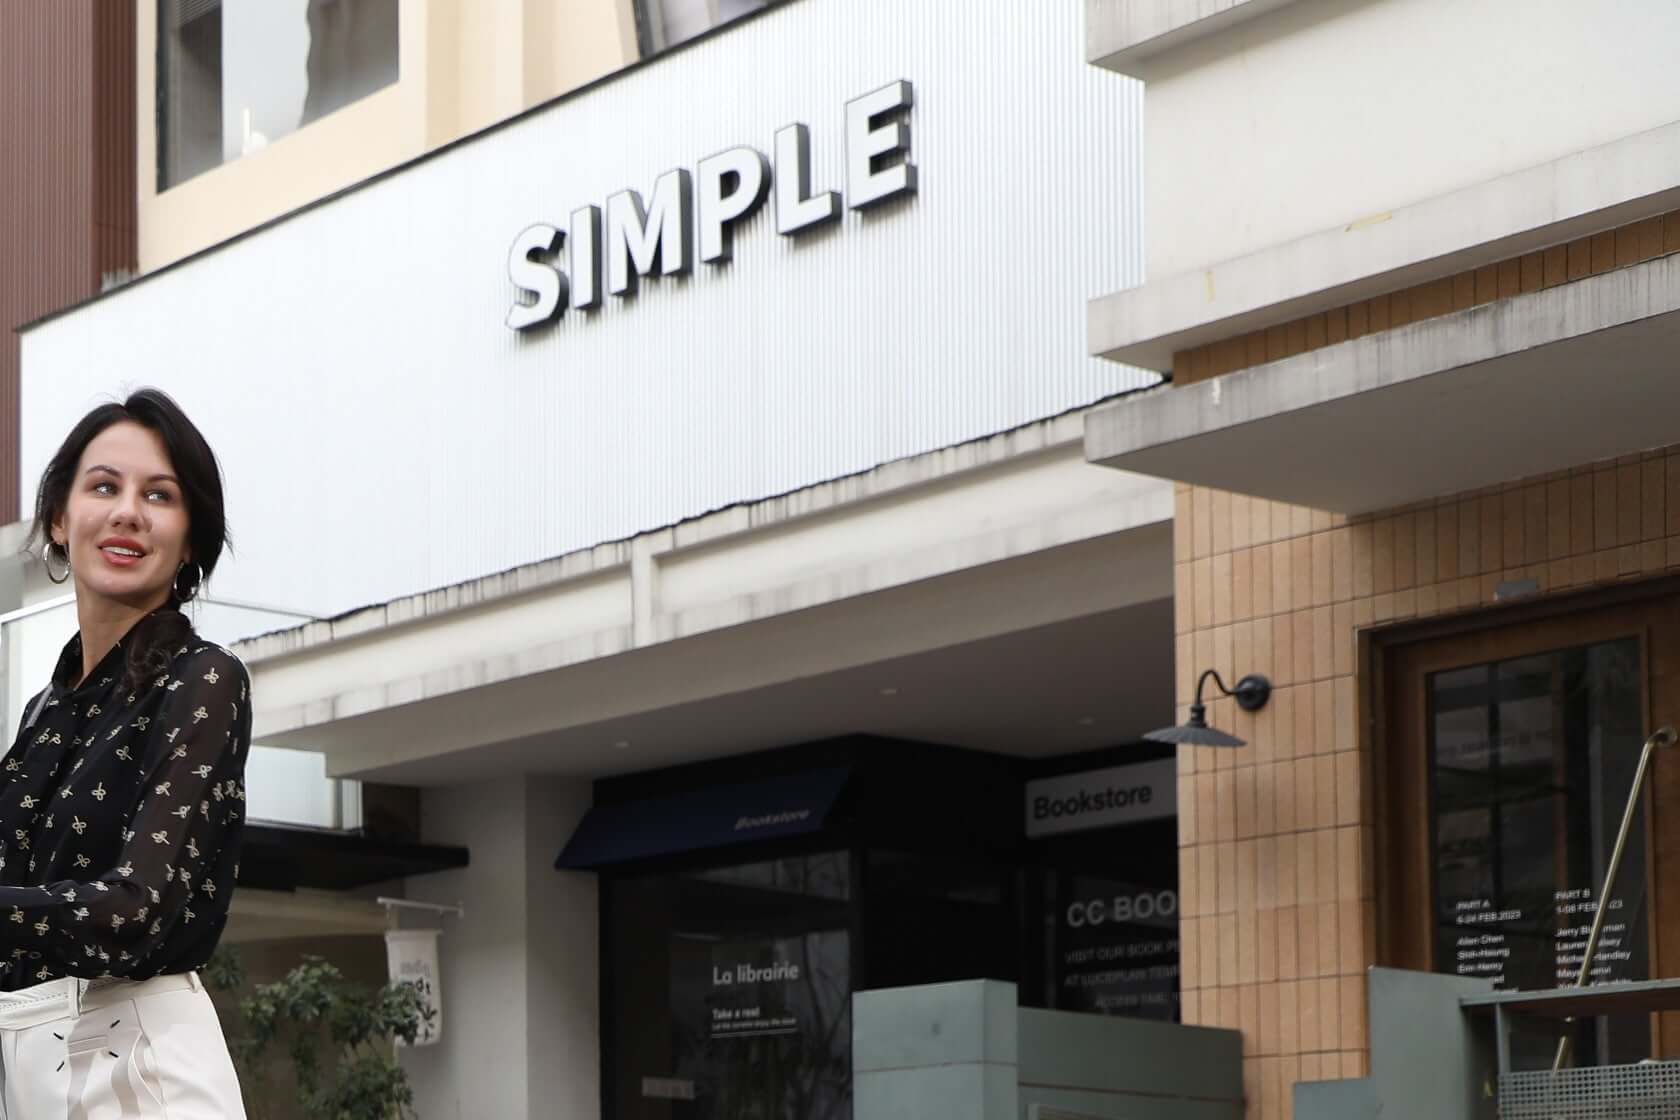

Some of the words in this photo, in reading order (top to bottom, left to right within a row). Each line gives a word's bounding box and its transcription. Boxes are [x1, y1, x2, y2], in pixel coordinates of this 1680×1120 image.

[505, 79, 917, 332] SIMPLE
[1033, 784, 1153, 820] Bookstore
[1066, 899, 1105, 929] CC
[1114, 889, 1177, 922] BOO
[713, 965, 732, 985] La
[737, 961, 799, 984] librairie
